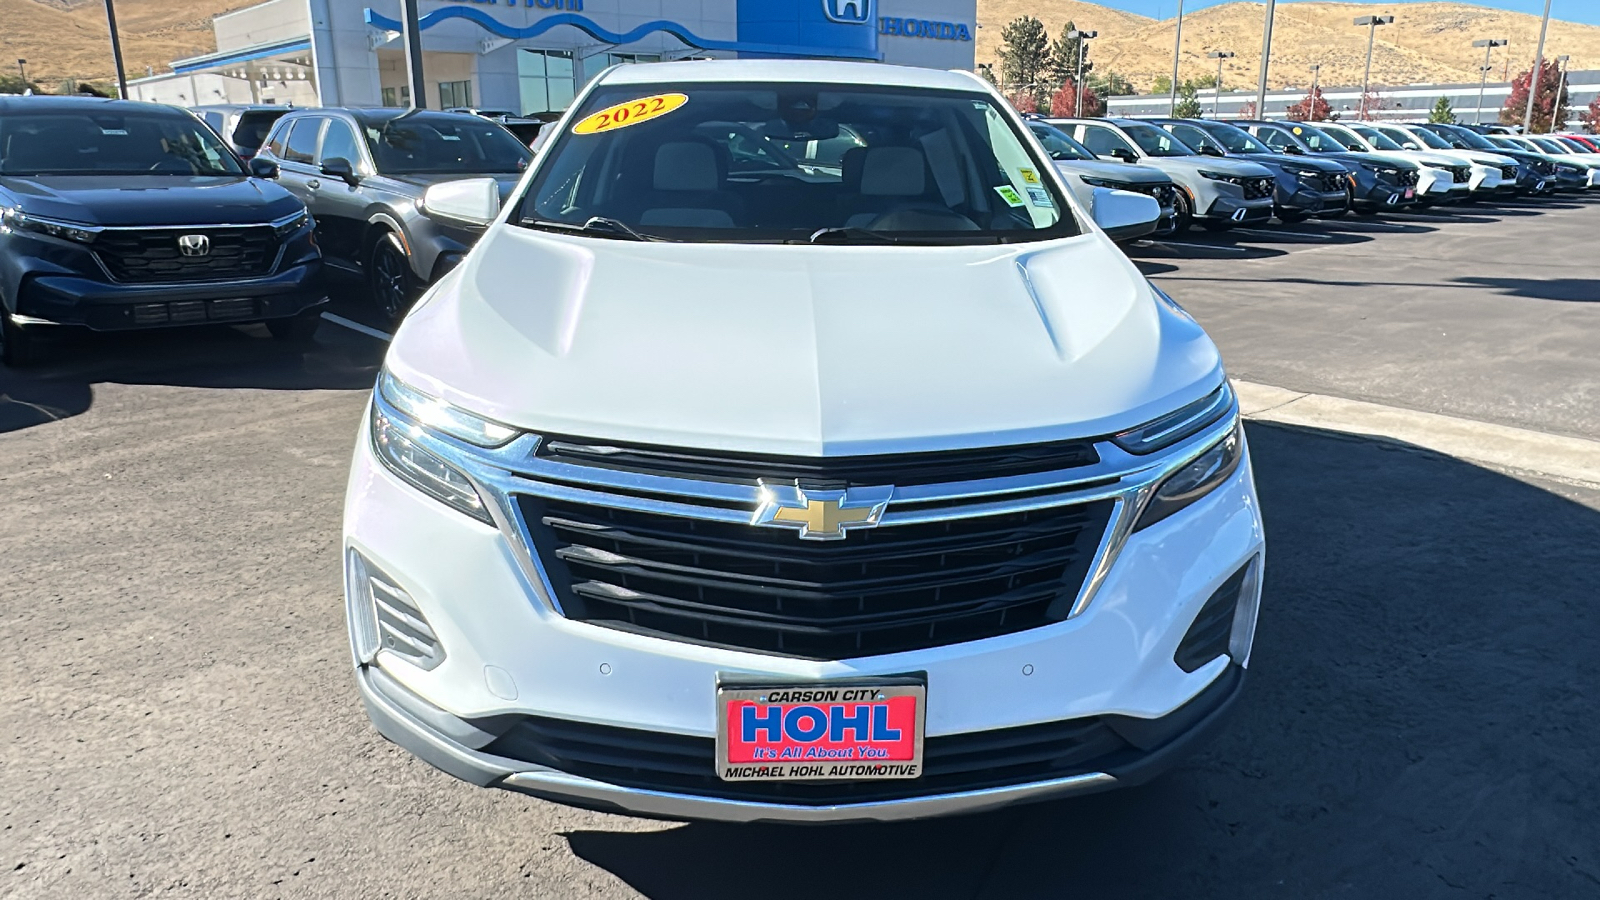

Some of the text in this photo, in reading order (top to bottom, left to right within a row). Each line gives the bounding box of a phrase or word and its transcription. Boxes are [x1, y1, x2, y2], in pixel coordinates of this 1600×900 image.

[879, 17, 972, 41] HONDA
[595, 97, 666, 130] 2022
[768, 688, 881, 703] CARSON CITY
[741, 705, 901, 743] HOHL
[753, 747, 777, 759] It's
[780, 747, 802, 758] All
[804, 747, 853, 758] About
[725, 764, 917, 778] MICHAEL HOHL AUTOMOTIVE
